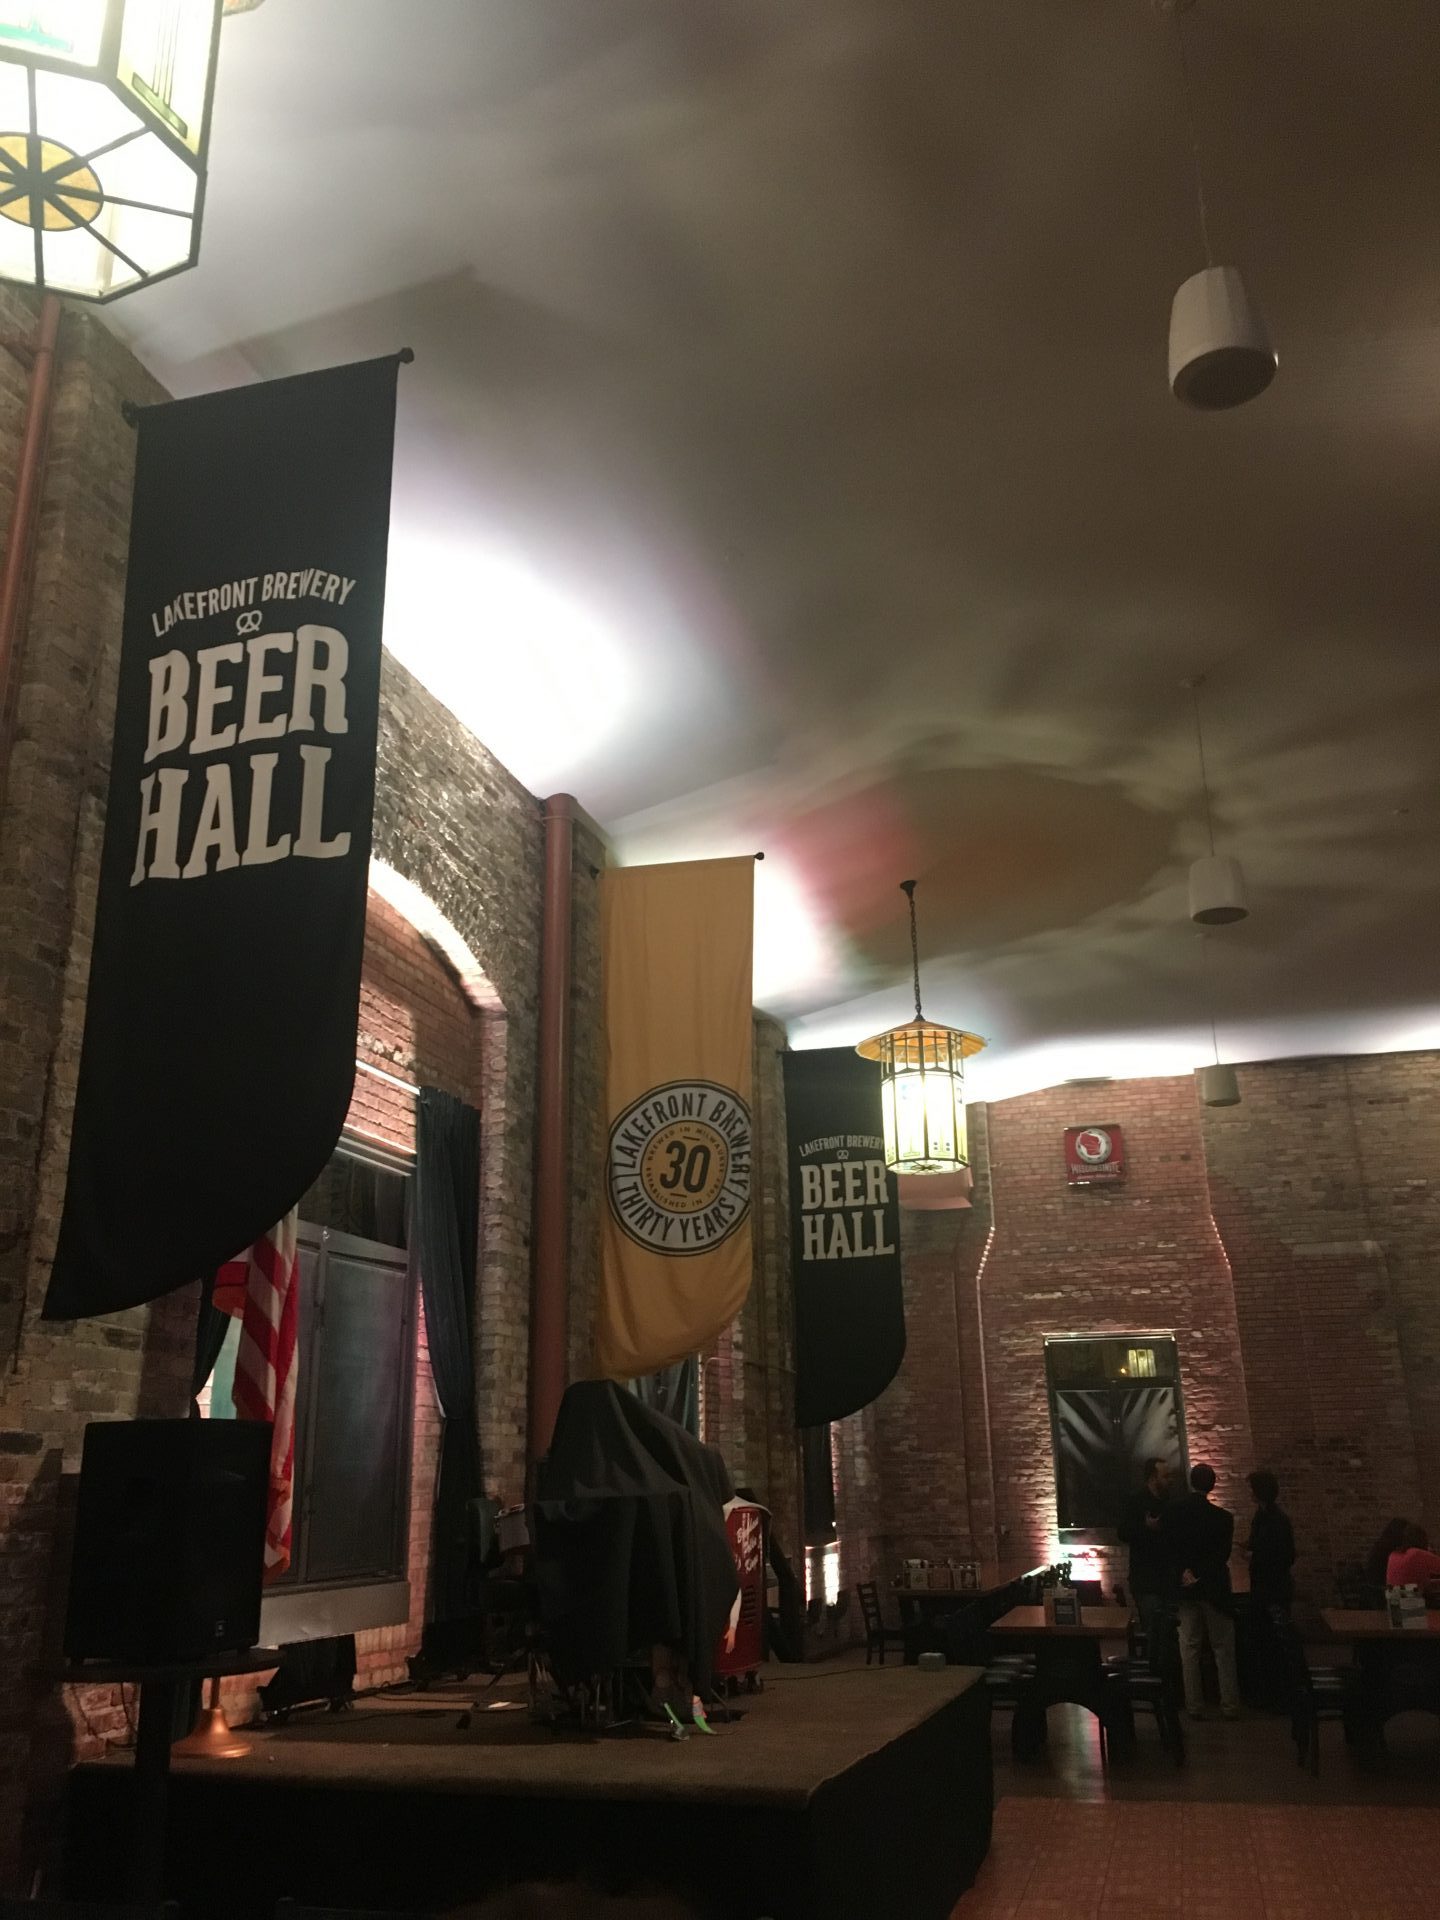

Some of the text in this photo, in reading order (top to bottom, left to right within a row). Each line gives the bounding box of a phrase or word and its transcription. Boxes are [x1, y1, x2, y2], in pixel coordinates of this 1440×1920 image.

[151, 567, 357, 638] LAKEFRONT BREWERY
[143, 623, 350, 765] BEER
[129, 743, 352, 888] HALL
[613, 1092, 751, 1191] LAKEFRONT BREWERY
[659, 1140, 712, 1194] 30
[799, 1135, 846, 1157] LAKEFRONT
[616, 1181, 736, 1243] THIRTY YEARS
[692, 1198, 704, 1207] IN
[800, 1159, 889, 1210] BEER
[801, 1209, 896, 1261] HALL
